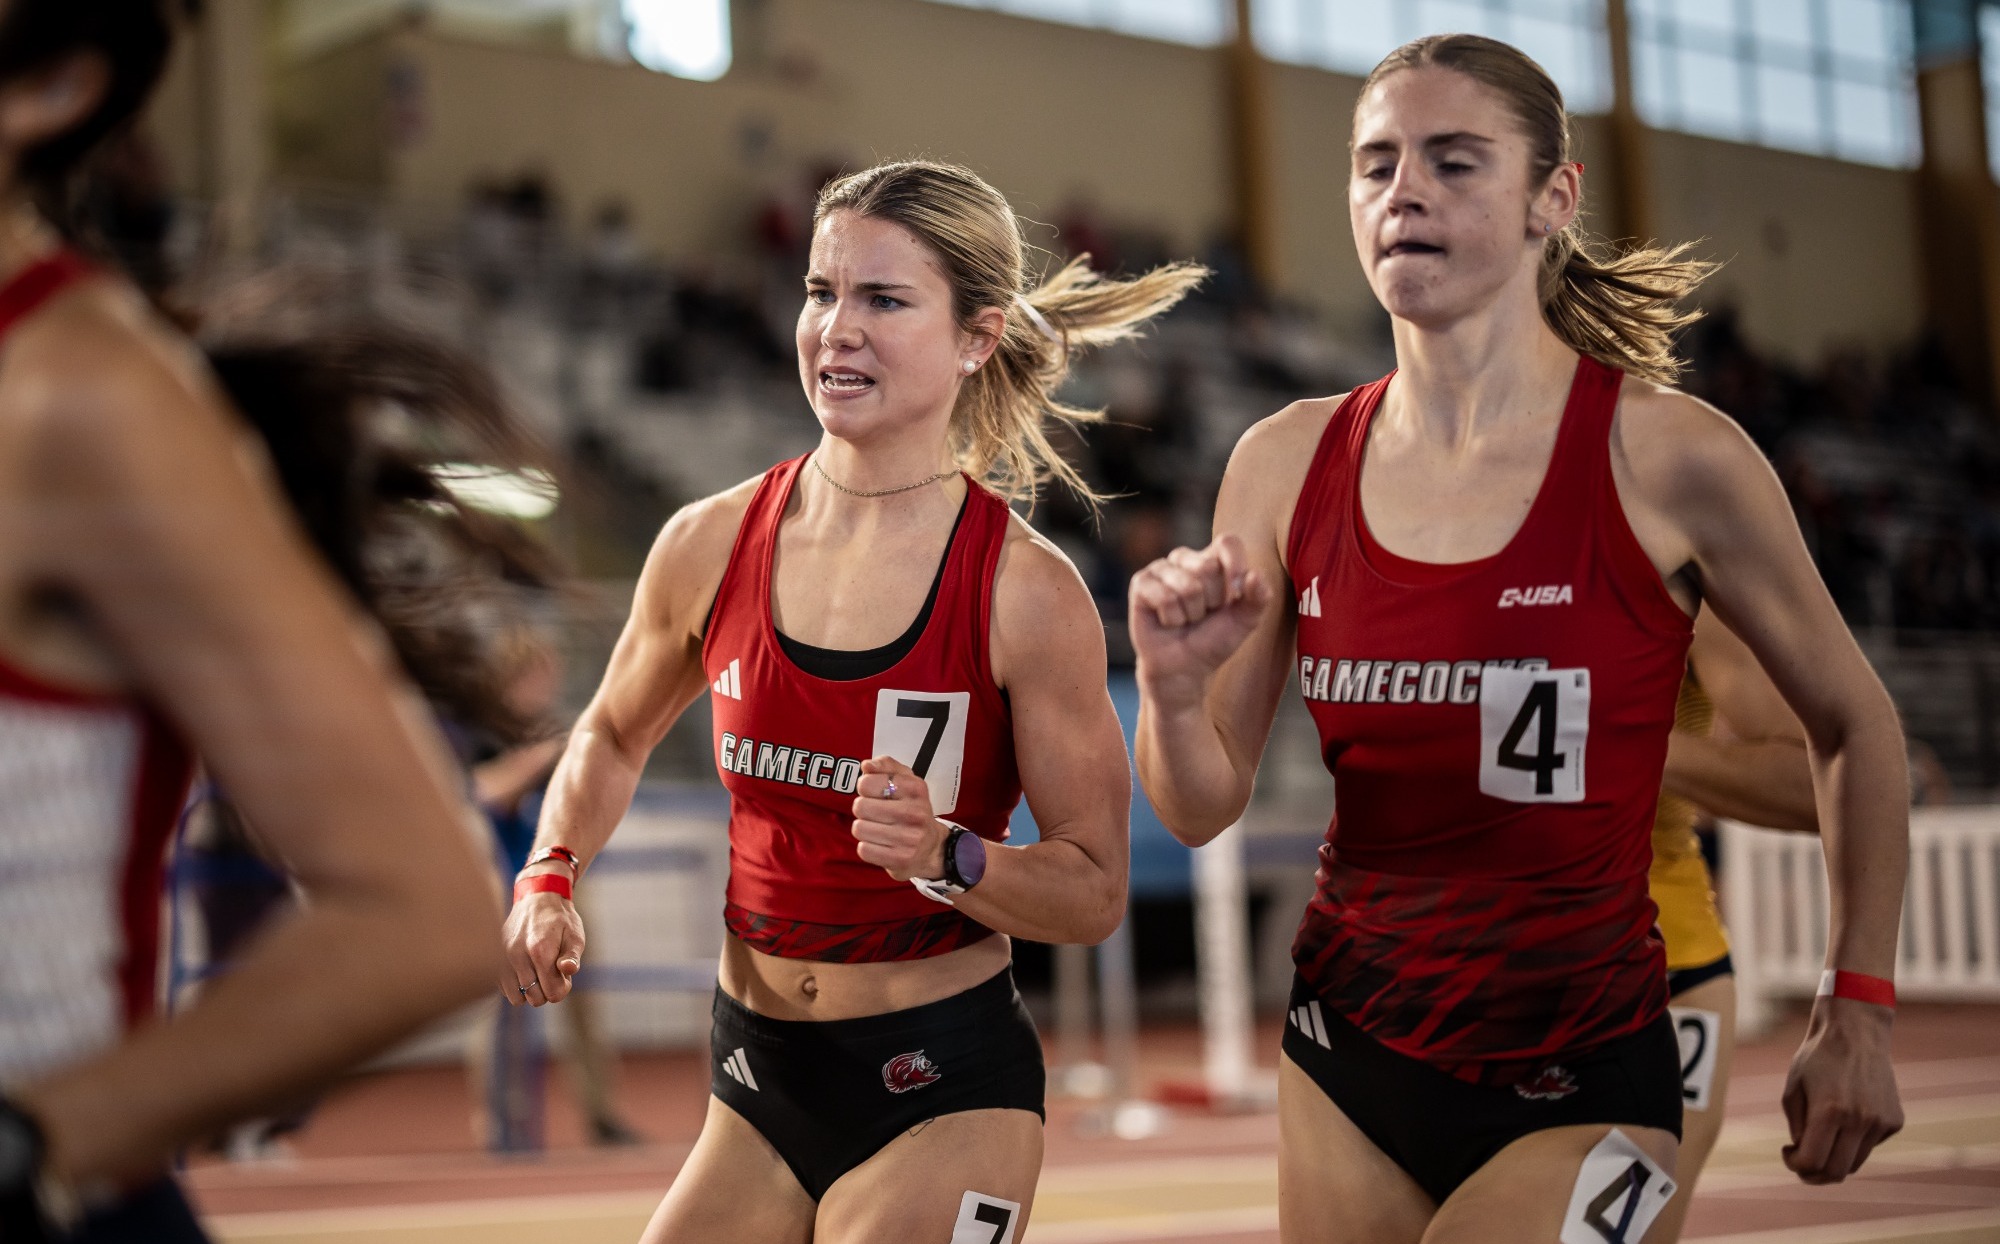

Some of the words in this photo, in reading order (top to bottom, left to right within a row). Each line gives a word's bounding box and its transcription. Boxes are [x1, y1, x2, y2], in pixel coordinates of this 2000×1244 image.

[1300, 656, 1550, 705] GAMECOC
[720, 731, 863, 794] GAMECO
[896, 698, 951, 780] 7
[1496, 680, 1565, 795] 4
[1583, 1159, 1653, 1244] 4
